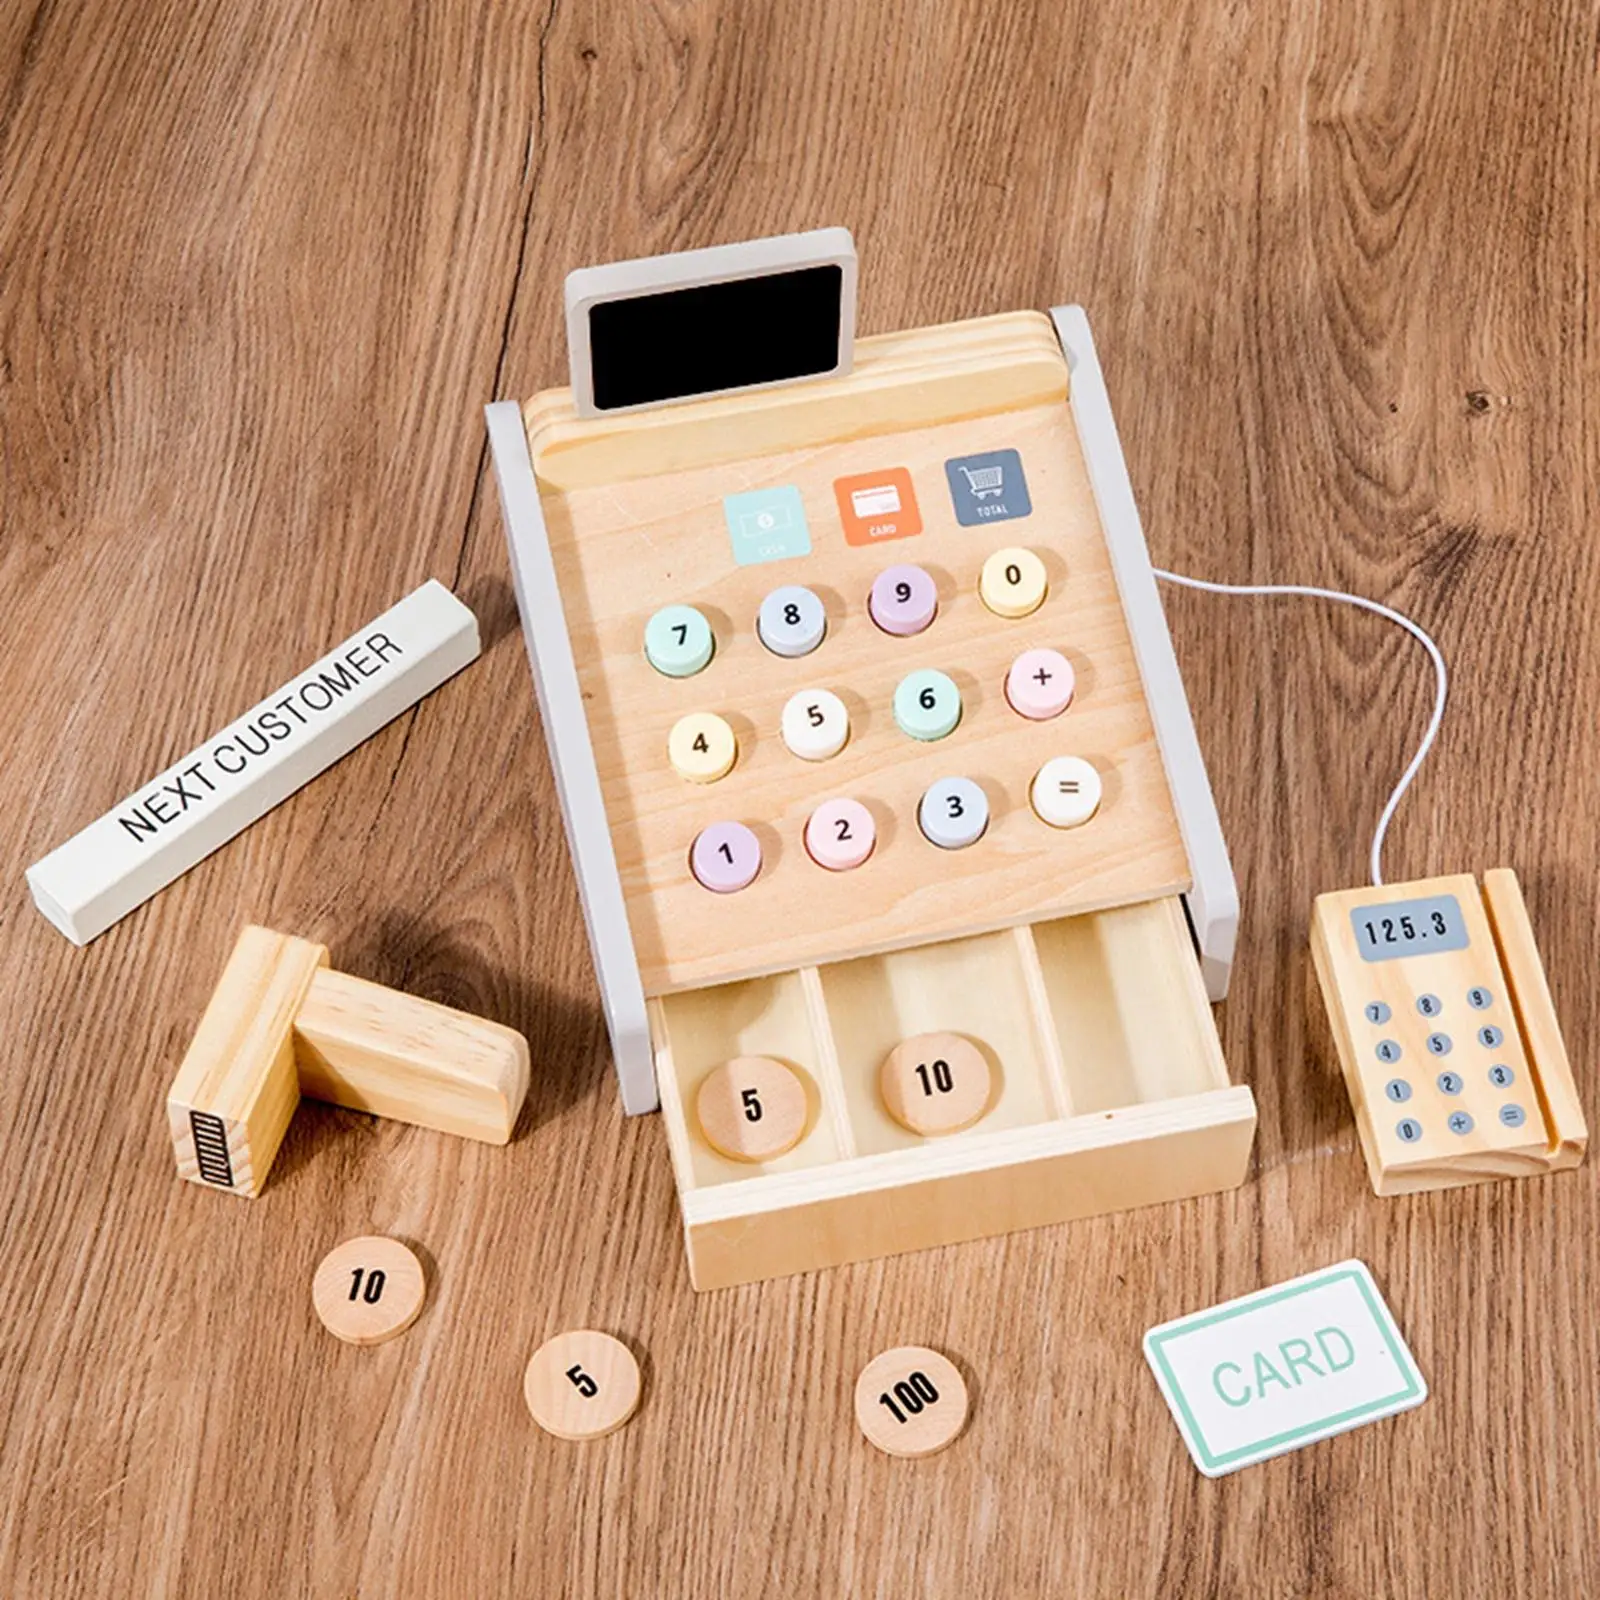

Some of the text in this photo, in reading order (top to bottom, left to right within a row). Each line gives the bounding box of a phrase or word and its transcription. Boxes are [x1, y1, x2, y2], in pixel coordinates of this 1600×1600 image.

[976, 504, 1009, 518] TOTAL
[868, 524, 897, 537] CARD
[1005, 564, 1022, 586] 0
[895, 582, 912, 604] 9
[783, 603, 801, 626] 8
[671, 624, 688, 646] 7
[919, 687, 937, 710] 6
[807, 704, 825, 728] 5
[118, 632, 403, 843] NEXT CUSTOMER
[692, 732, 709, 754] 4
[946, 795, 964, 819] 3
[834, 819, 853, 842] 2
[718, 842, 735, 864] 1
[1364, 911, 1448, 946] 125.3
[1421, 998, 1433, 1014] 8
[1472, 990, 1484, 1006] 9
[1370, 1004, 1381, 1021] 7
[1431, 1036, 1443, 1052] 5
[1483, 1028, 1495, 1045] 6
[1381, 1044, 1392, 1060] 4
[915, 1059, 954, 1097] 10
[1443, 1075, 1454, 1092] 2
[1494, 1067, 1506, 1084] 3
[1392, 1084, 1402, 1099] 1
[741, 1088, 764, 1124] 5
[1402, 1123, 1414, 1140] 0
[348, 1267, 387, 1305] 10
[1212, 1326, 1356, 1406] CARD
[565, 1364, 599, 1399] 5
[879, 1371, 941, 1425] 100
